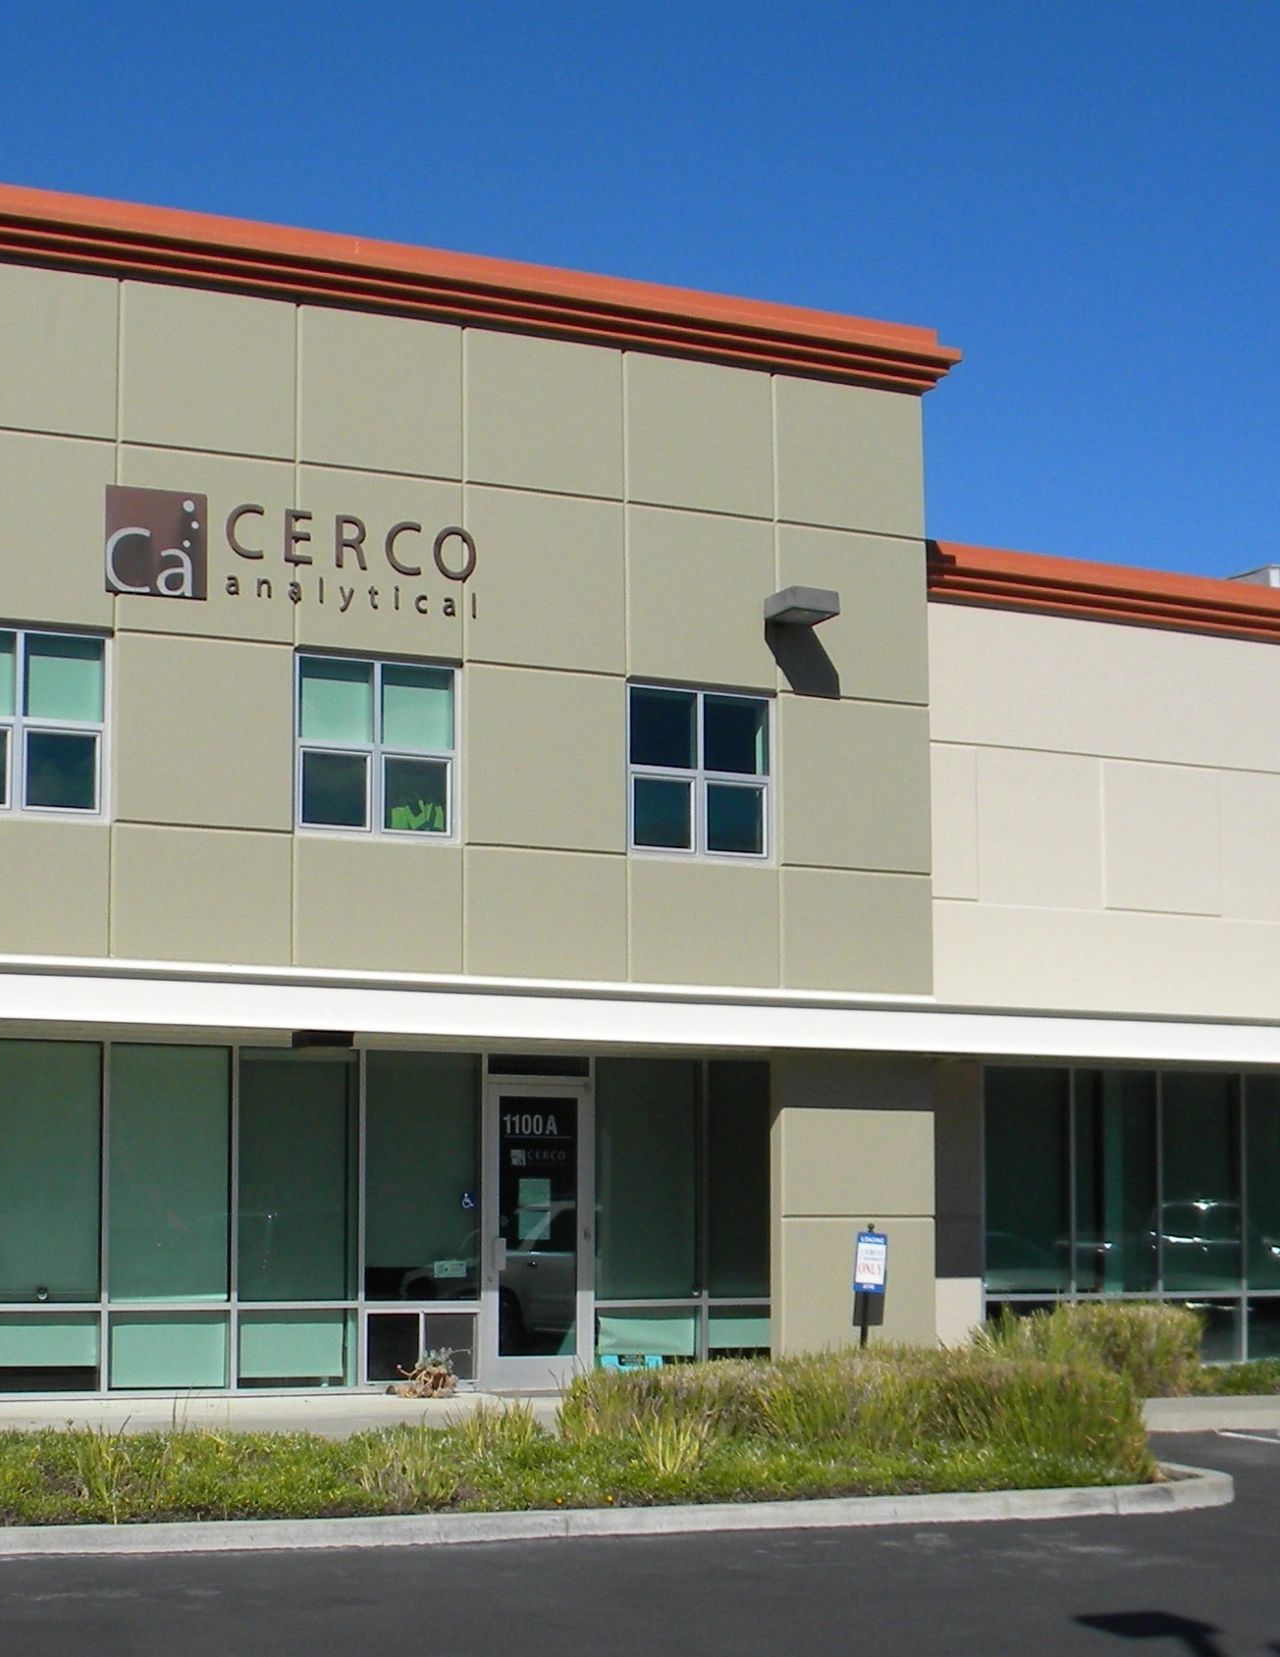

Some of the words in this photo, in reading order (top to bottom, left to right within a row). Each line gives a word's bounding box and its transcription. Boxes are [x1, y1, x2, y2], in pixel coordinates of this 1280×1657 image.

[225, 503, 477, 582] CERCO
[225, 574, 478, 619] analytical
[503, 1113, 558, 1135] 1100A
[858, 1263, 882, 1275] ONLY
